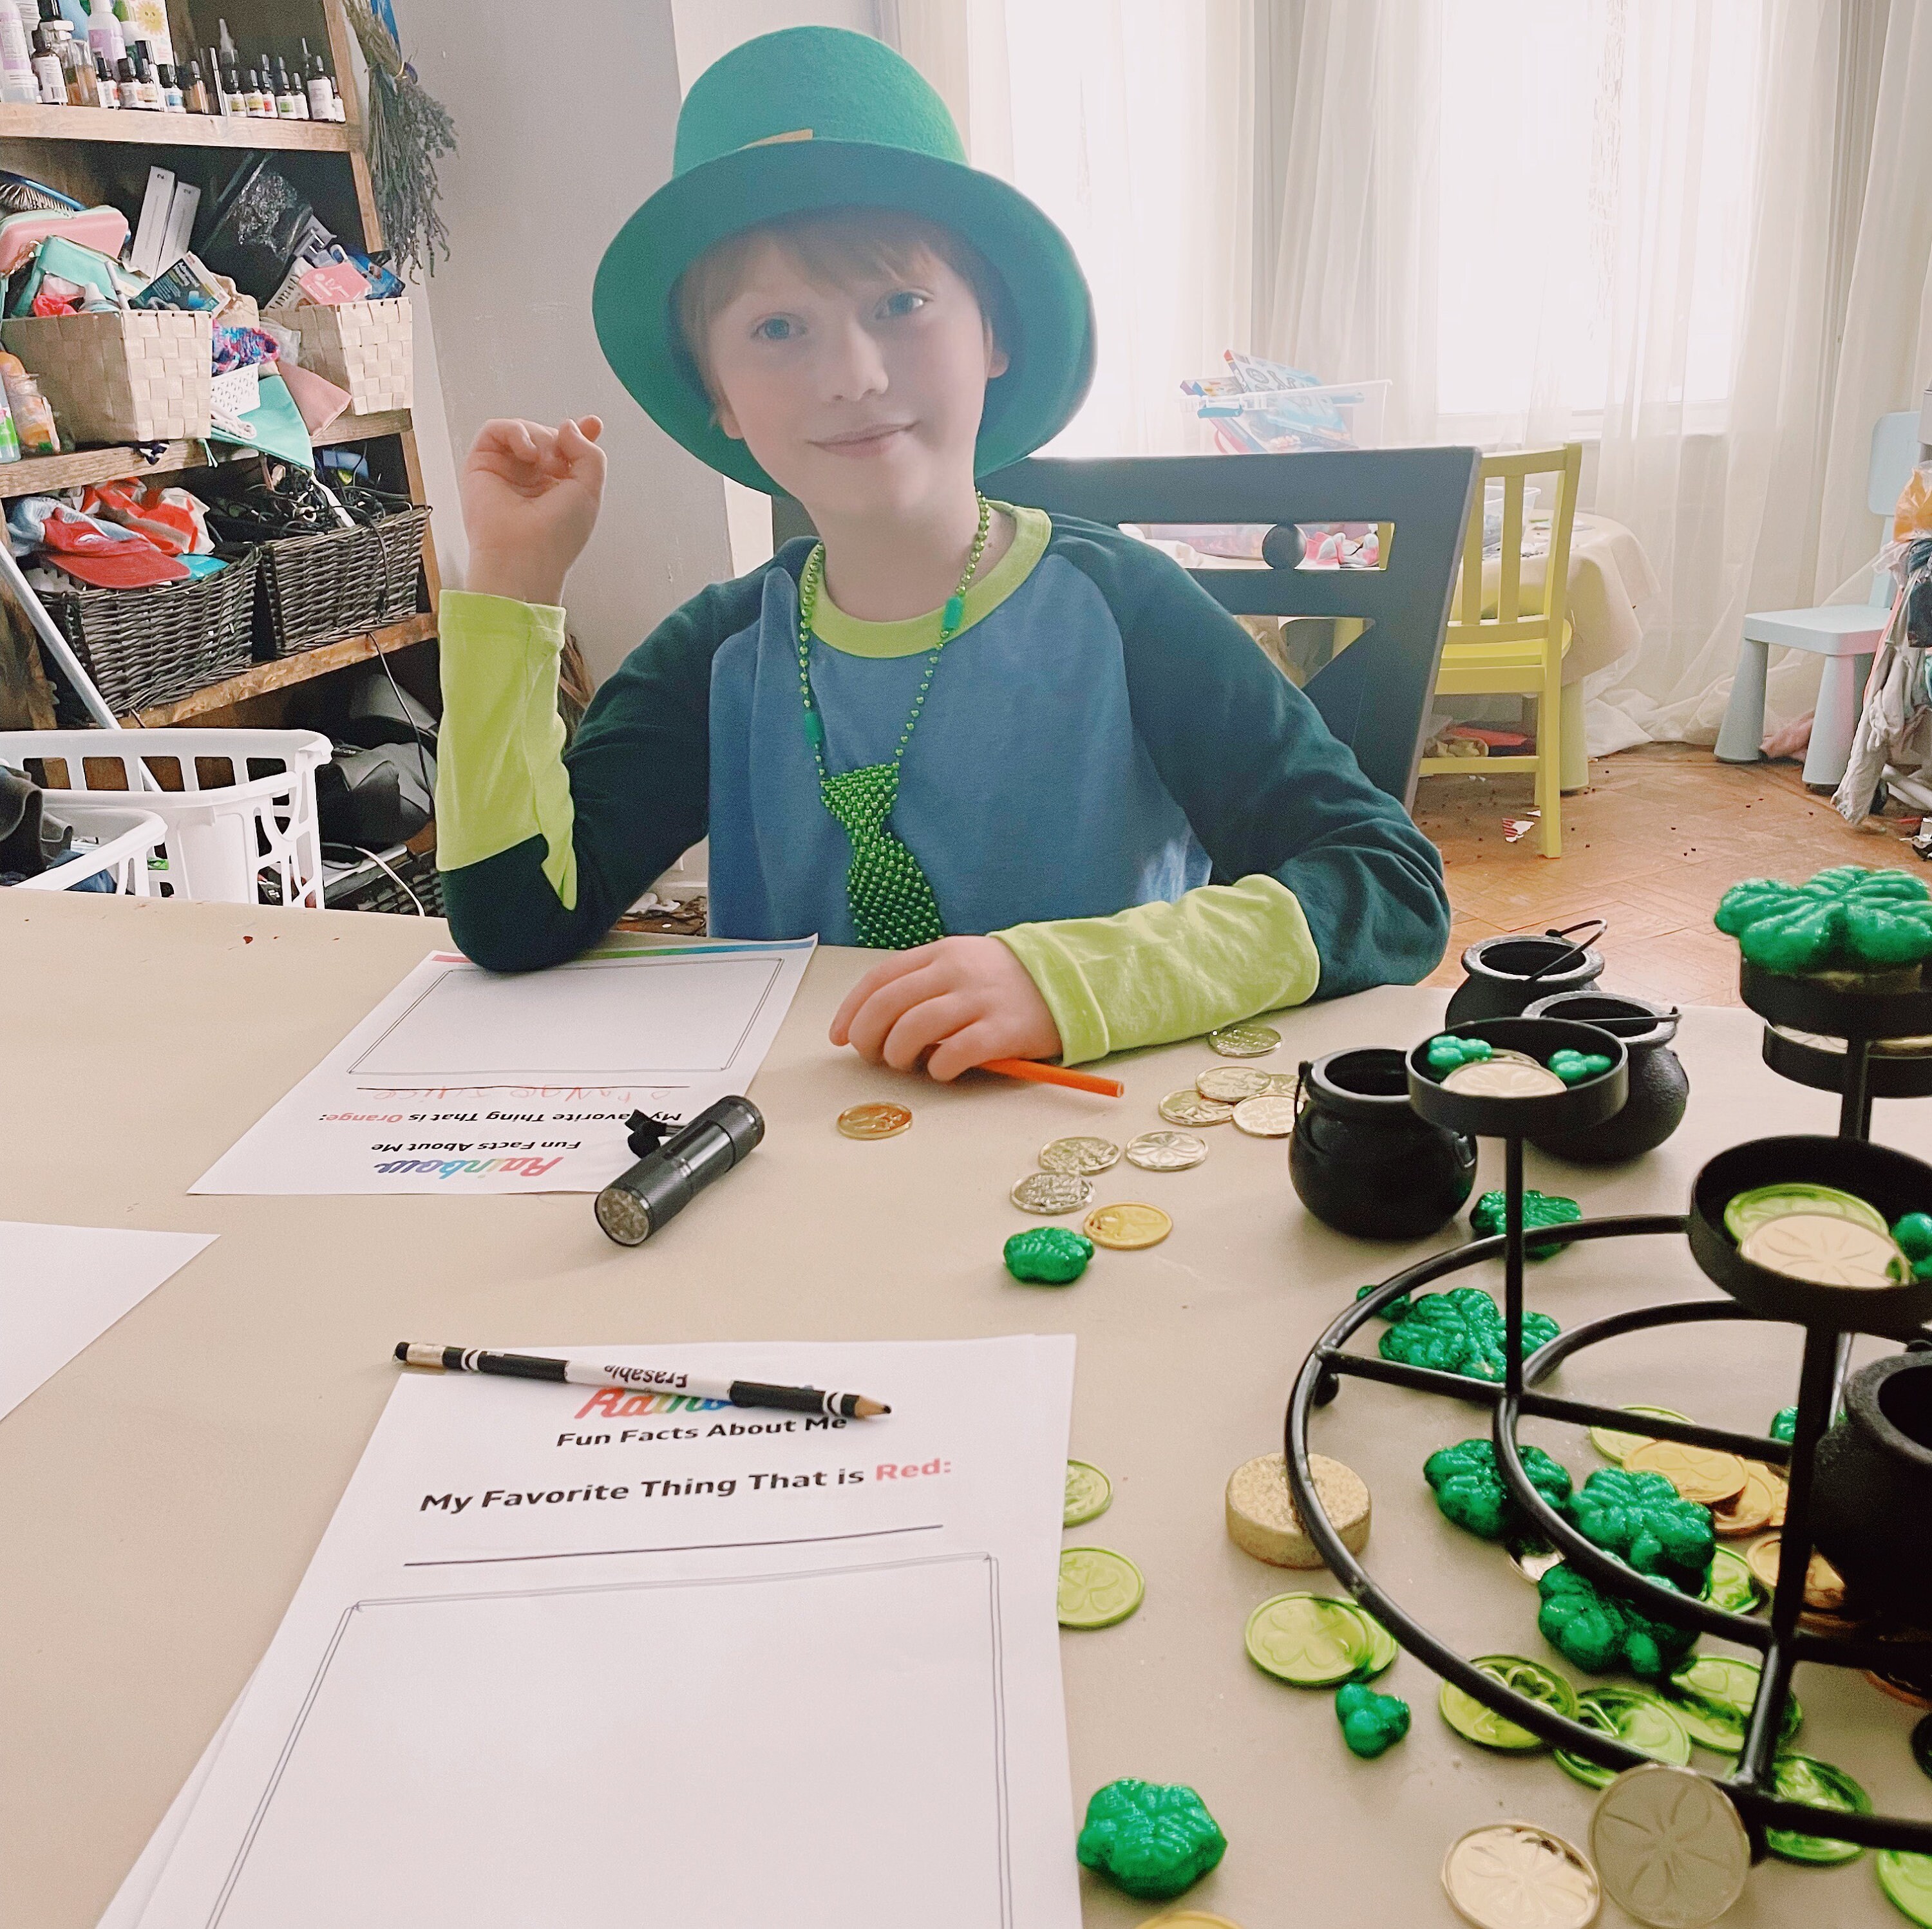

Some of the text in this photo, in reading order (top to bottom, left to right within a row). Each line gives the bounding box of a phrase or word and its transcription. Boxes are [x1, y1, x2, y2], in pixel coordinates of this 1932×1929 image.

[317, 1111, 682, 1124] My avorite Thing That is Orange:
[371, 1141, 582, 1153] Fun Facts About Me
[374, 1156, 565, 1180] Rainbow
[604, 1364, 688, 1388] Erasable
[556, 1415, 848, 1447] Fun Facts About Me
[420, 1458, 951, 1515] My Favorite Thing That is Red:
